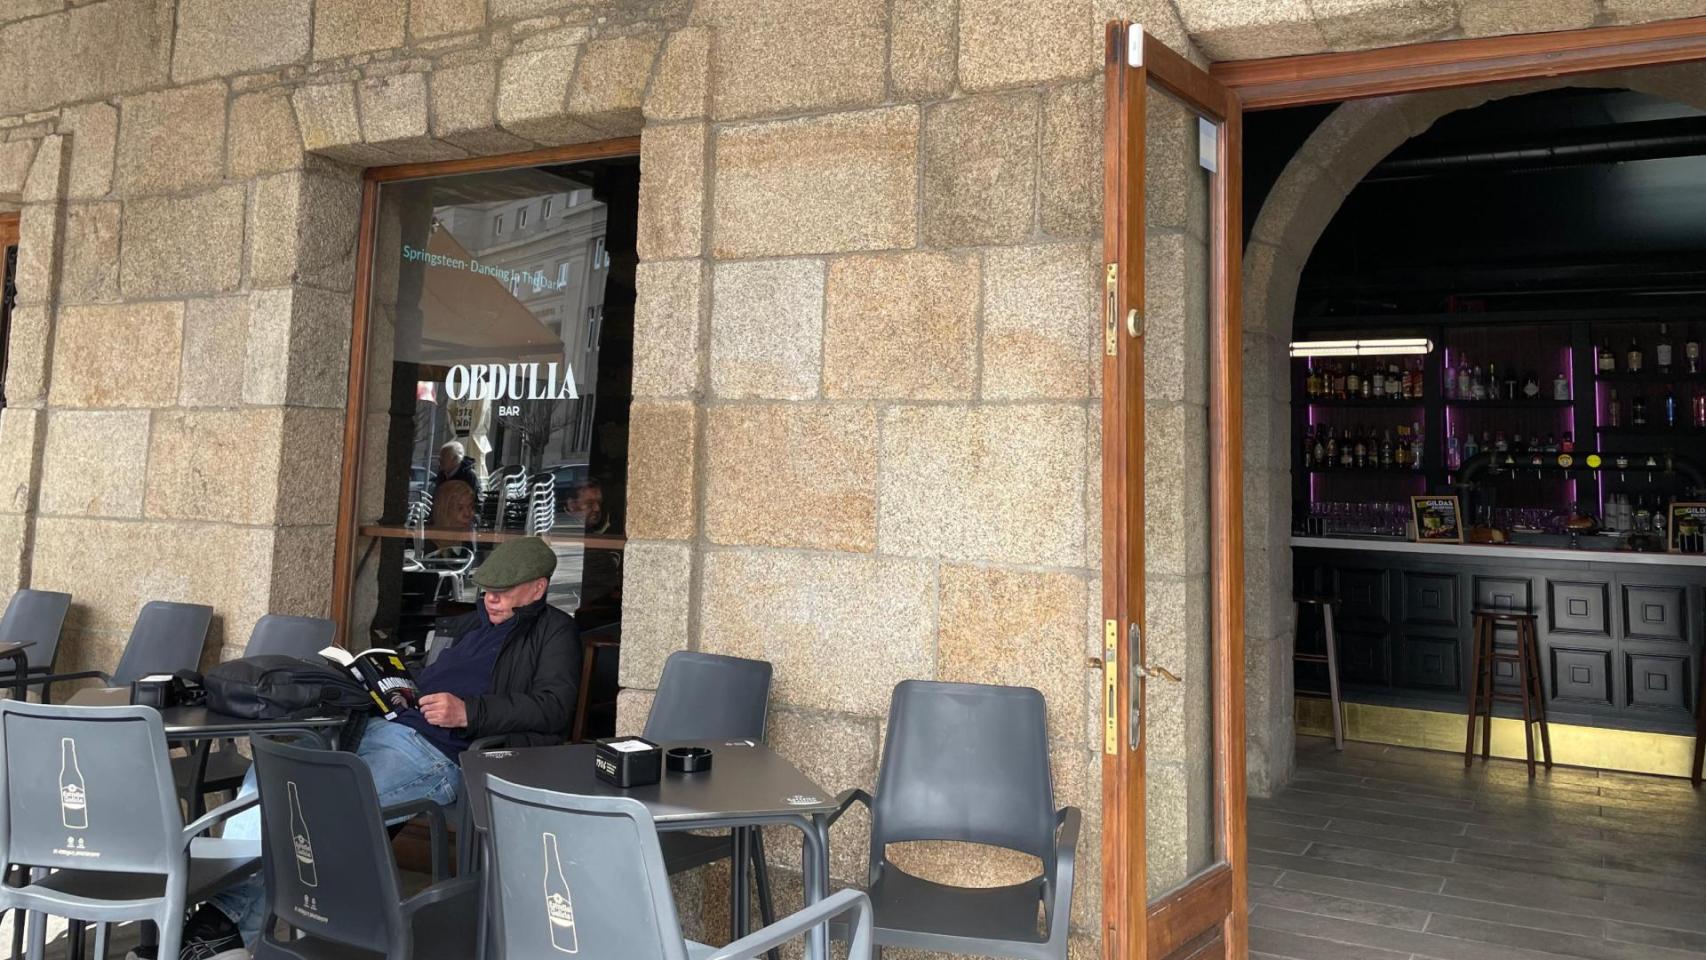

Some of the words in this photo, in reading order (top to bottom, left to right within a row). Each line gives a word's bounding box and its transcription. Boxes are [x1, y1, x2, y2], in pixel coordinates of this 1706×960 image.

[470, 260, 510, 281] Dancing
[521, 271, 540, 286] The
[541, 275, 562, 291] Dark
[445, 362, 579, 401] OBDULIA
[498, 405, 520, 417] BAR
